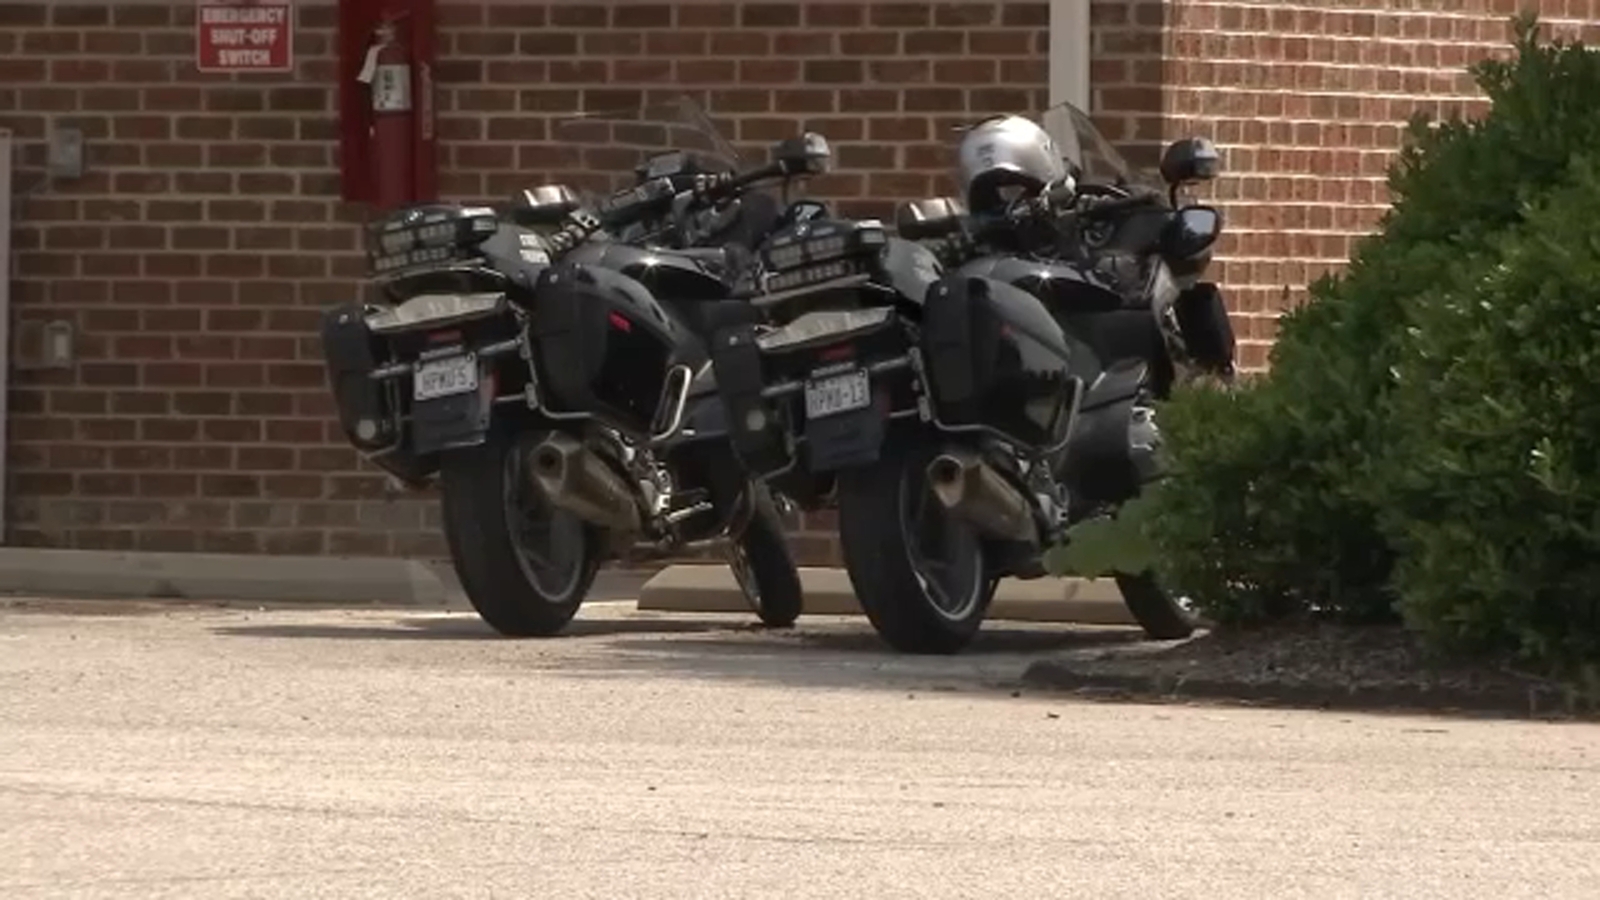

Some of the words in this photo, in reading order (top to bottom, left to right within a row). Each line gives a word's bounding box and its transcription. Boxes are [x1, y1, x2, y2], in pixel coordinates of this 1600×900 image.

[202, 7, 285, 24] EMERGENCY
[210, 28, 278, 46] SHUT-OFF
[218, 49, 271, 66] SWITCH
